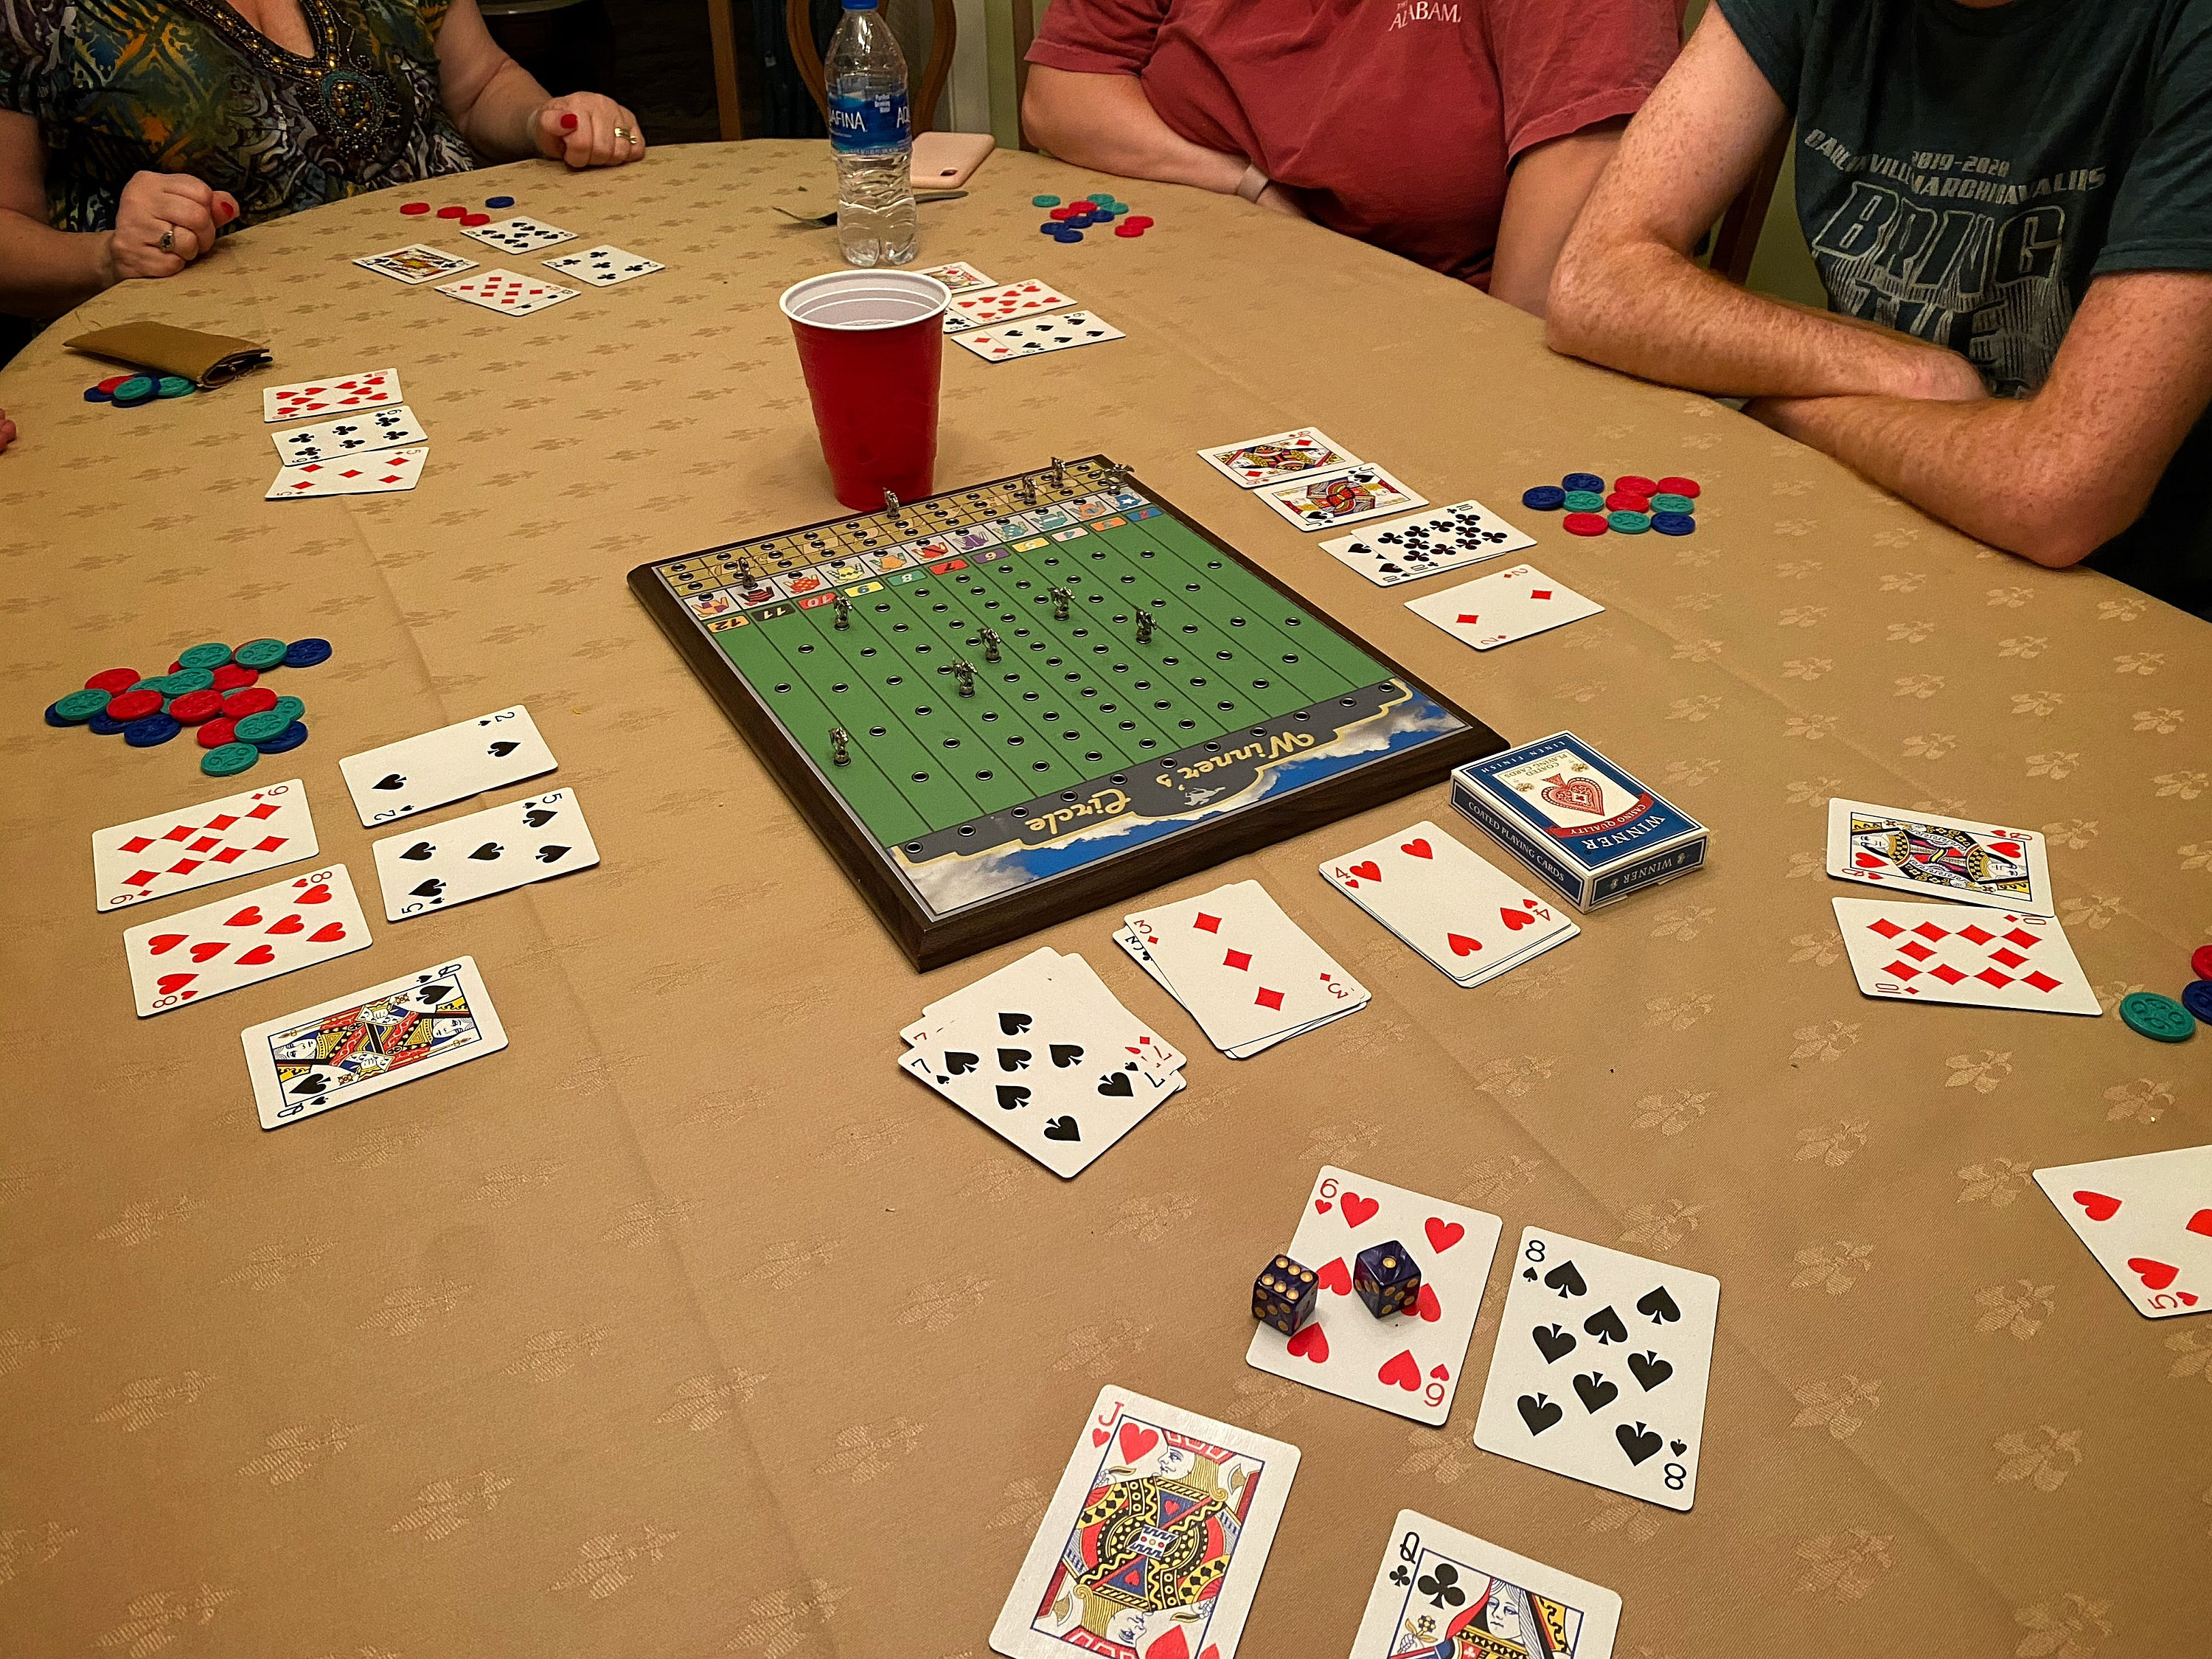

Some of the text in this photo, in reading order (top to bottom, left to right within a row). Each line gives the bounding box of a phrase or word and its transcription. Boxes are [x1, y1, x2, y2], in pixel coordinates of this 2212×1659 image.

[1388, 1, 1461, 31] ALABAM
[829, 110, 865, 132] AFINA
[764, 608, 786, 619] 11
[715, 619, 741, 630] 12
[495, 712, 515, 722] 2
[1481, 741, 1565, 773] LINEN FINISH
[1504, 754, 1568, 778] PLAYING CARDS
[1526, 762, 1559, 776] COATED
[1026, 732, 1315, 834] Winner's Circle
[543, 793, 562, 804] 5
[374, 810, 395, 820] 2
[1571, 804, 1646, 835] CASINO QUALITY
[1581, 815, 1666, 849] WINNER
[1468, 801, 1564, 881] COATED PLAYING CARDS
[310, 871, 333, 883] 8
[1335, 867, 1351, 878] 4
[1624, 858, 1672, 883] WINNER
[402, 903, 423, 914] 5
[1532, 908, 1551, 922] 4
[1133, 920, 1152, 933] 3
[439, 964, 462, 977] Q
[1328, 983, 1349, 999] 3
[1875, 983, 1902, 994] 10
[153, 995, 177, 1008] 8
[911, 1058, 931, 1074] 7
[1144, 1072, 1166, 1088] 7
[277, 1103, 304, 1118] Q
[1321, 1178, 1339, 1198] 6
[1526, 1239, 1545, 1262] 8
[2147, 1294, 2178, 1310] 5
[1423, 1383, 1444, 1407] 6
[1099, 1402, 1124, 1426] J
[1664, 1463, 1686, 1490] 8
[1399, 1531, 1420, 1565] Q
